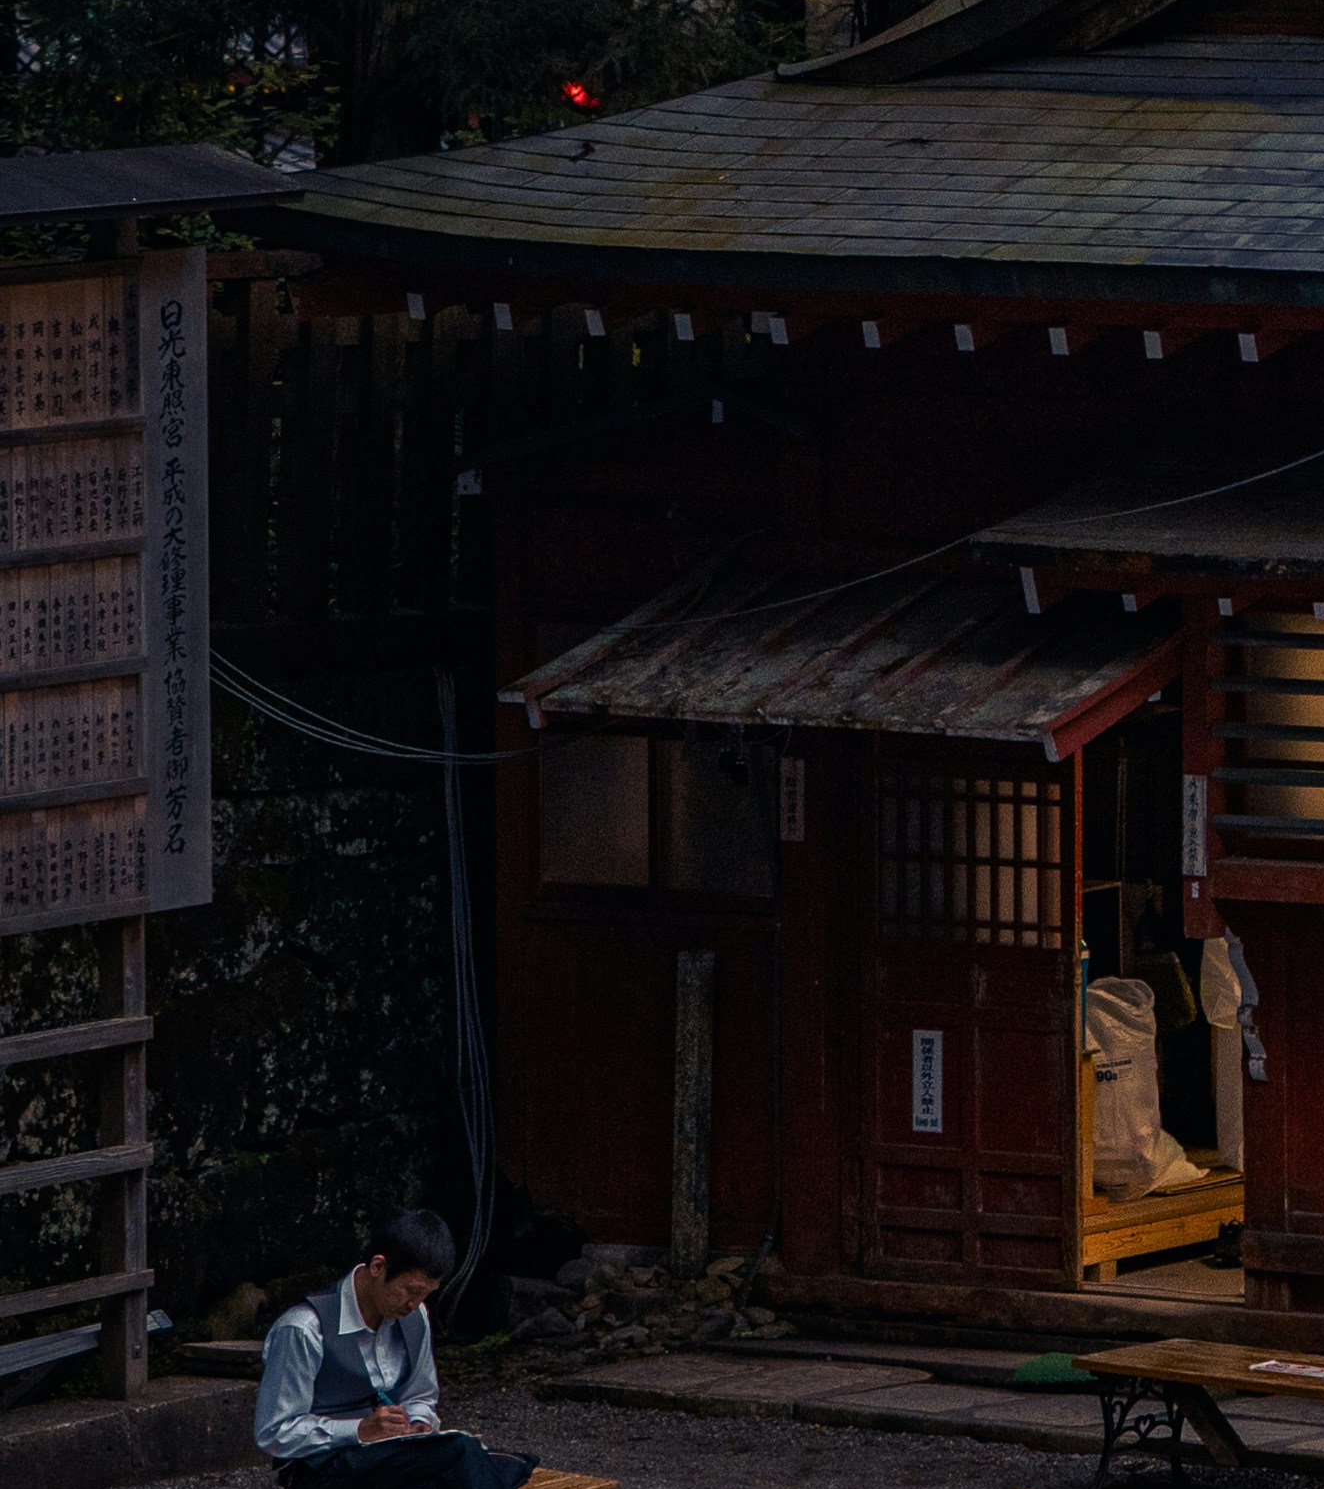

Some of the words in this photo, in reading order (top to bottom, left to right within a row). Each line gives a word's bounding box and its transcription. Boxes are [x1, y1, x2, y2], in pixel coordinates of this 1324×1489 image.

[158, 300, 187, 449] 日光東照宮
[159, 456, 188, 665] 平成の大修理事業
[163, 666, 189, 854] 協賛者御芳名
